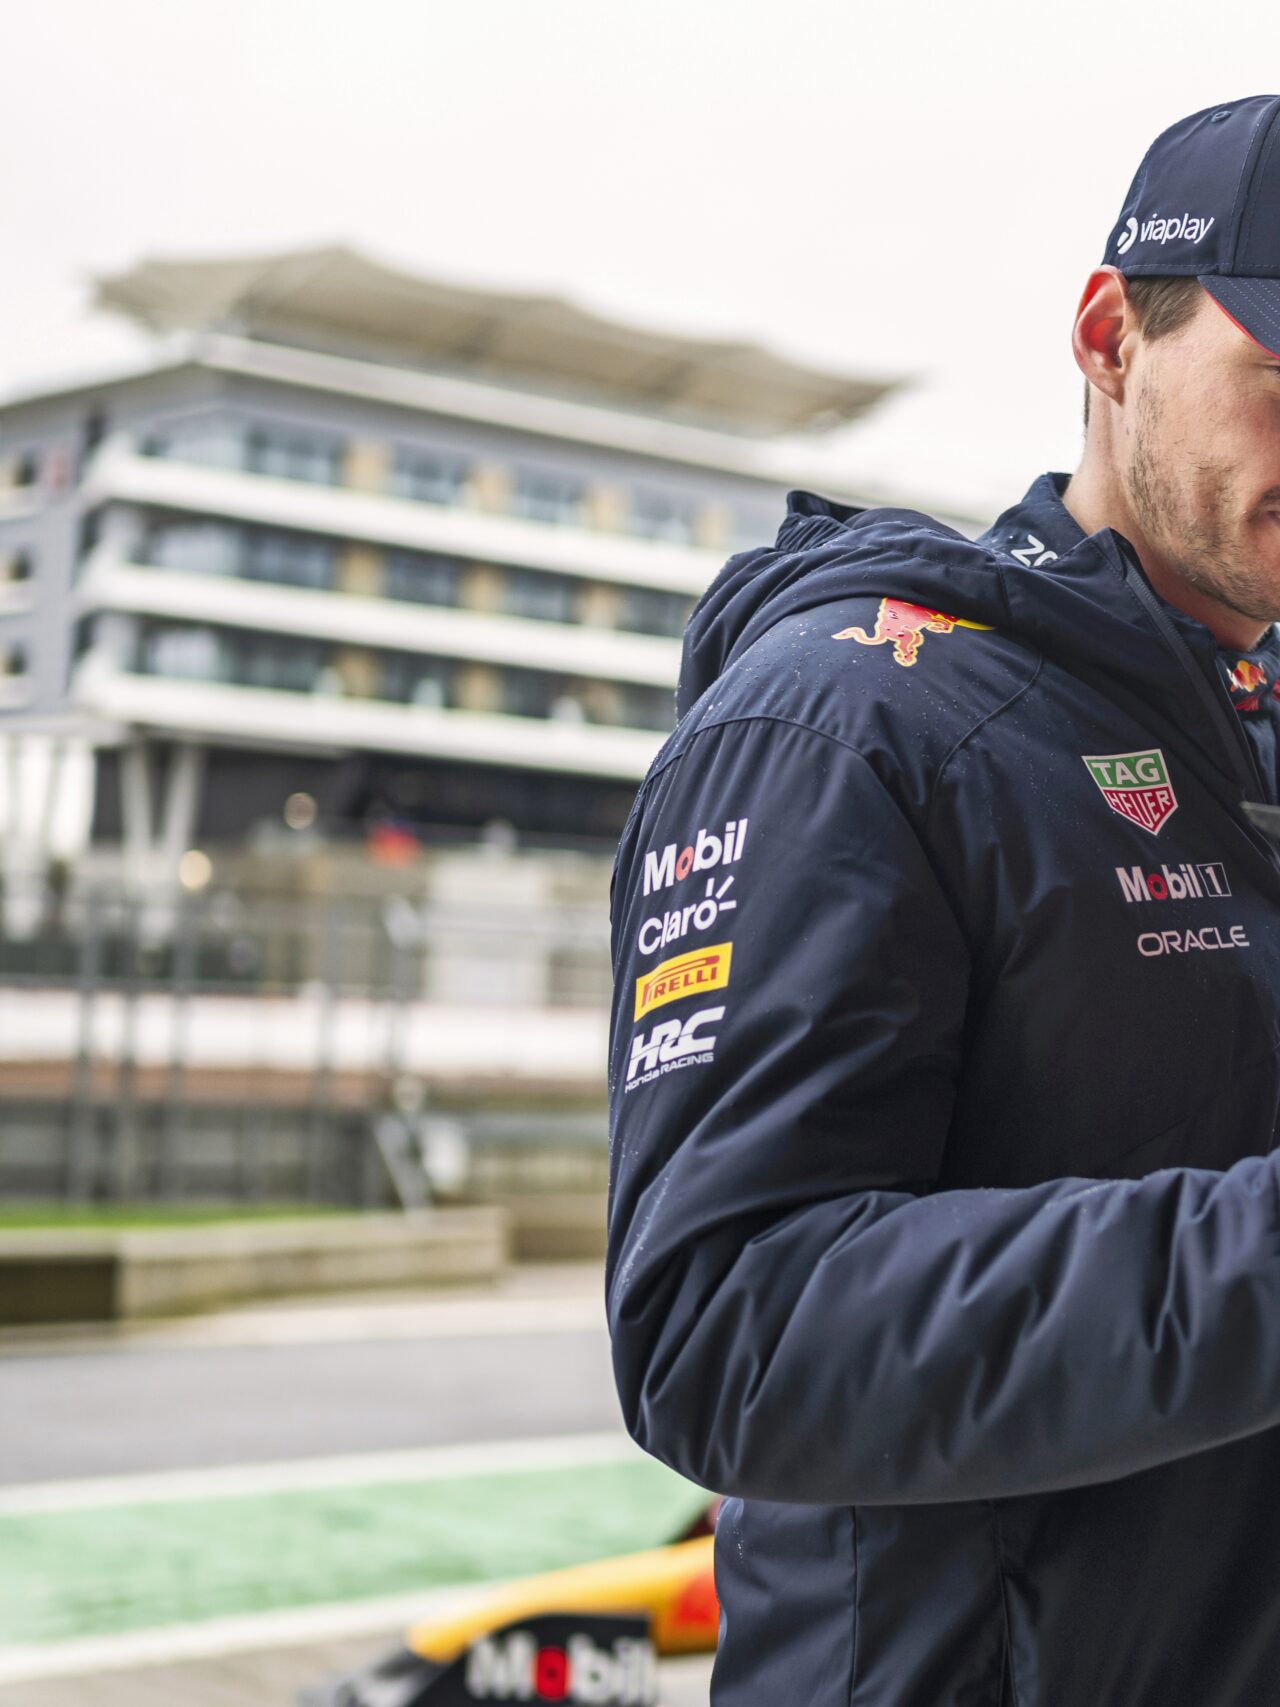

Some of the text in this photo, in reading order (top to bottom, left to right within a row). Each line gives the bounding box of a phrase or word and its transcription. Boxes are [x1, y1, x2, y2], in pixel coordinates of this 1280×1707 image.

[1140, 212, 1215, 245] viaplay
[1091, 757, 1160, 785] TAG
[1106, 790, 1171, 829] HEUER
[642, 818, 748, 897] Mobil
[1115, 863, 1204, 903] Mobil
[638, 897, 718, 955] Claro
[1137, 925, 1250, 957] ORACLE
[641, 955, 720, 1008] PIRELLI
[626, 1005, 726, 1082] HRC
[464, 1631, 660, 1707] Mobil
